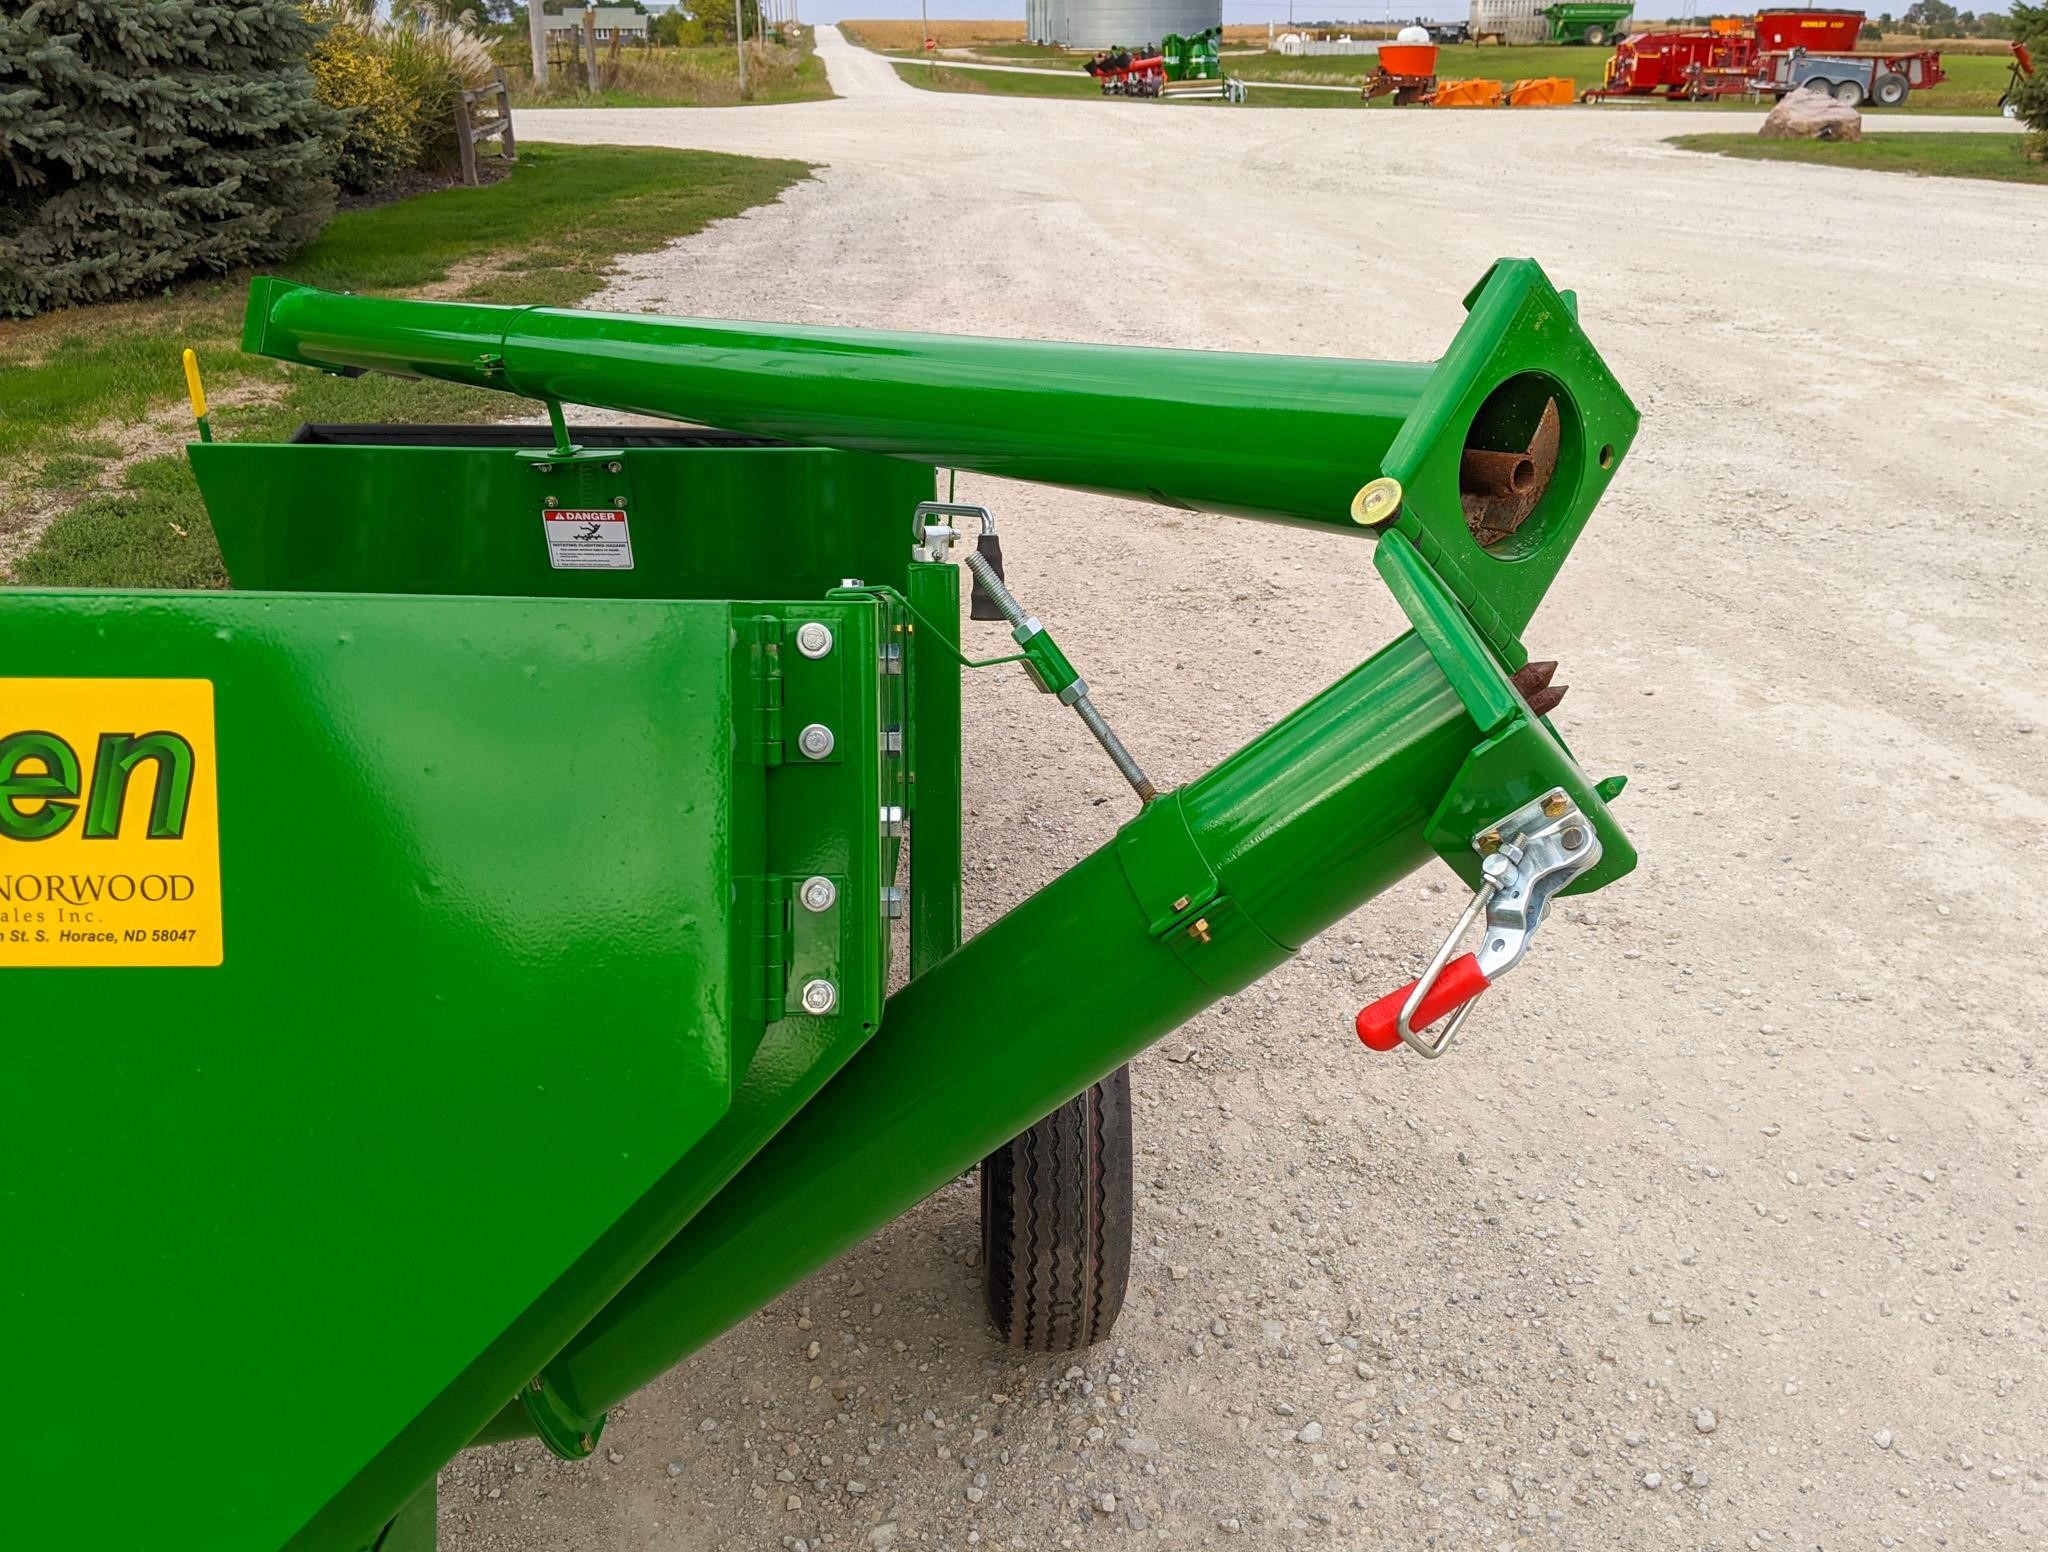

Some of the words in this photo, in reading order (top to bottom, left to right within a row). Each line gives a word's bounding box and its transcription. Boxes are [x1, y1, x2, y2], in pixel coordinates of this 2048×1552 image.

[565, 512, 616, 521] DANGER
[1, 907, 45, 922] ales
[58, 908, 103, 923] Inc.
[9, 929, 30, 943] St.
[35, 929, 50, 943] S.
[60, 930, 118, 945] Horace,
[124, 930, 147, 943] ND
[152, 929, 196, 943] 58047
